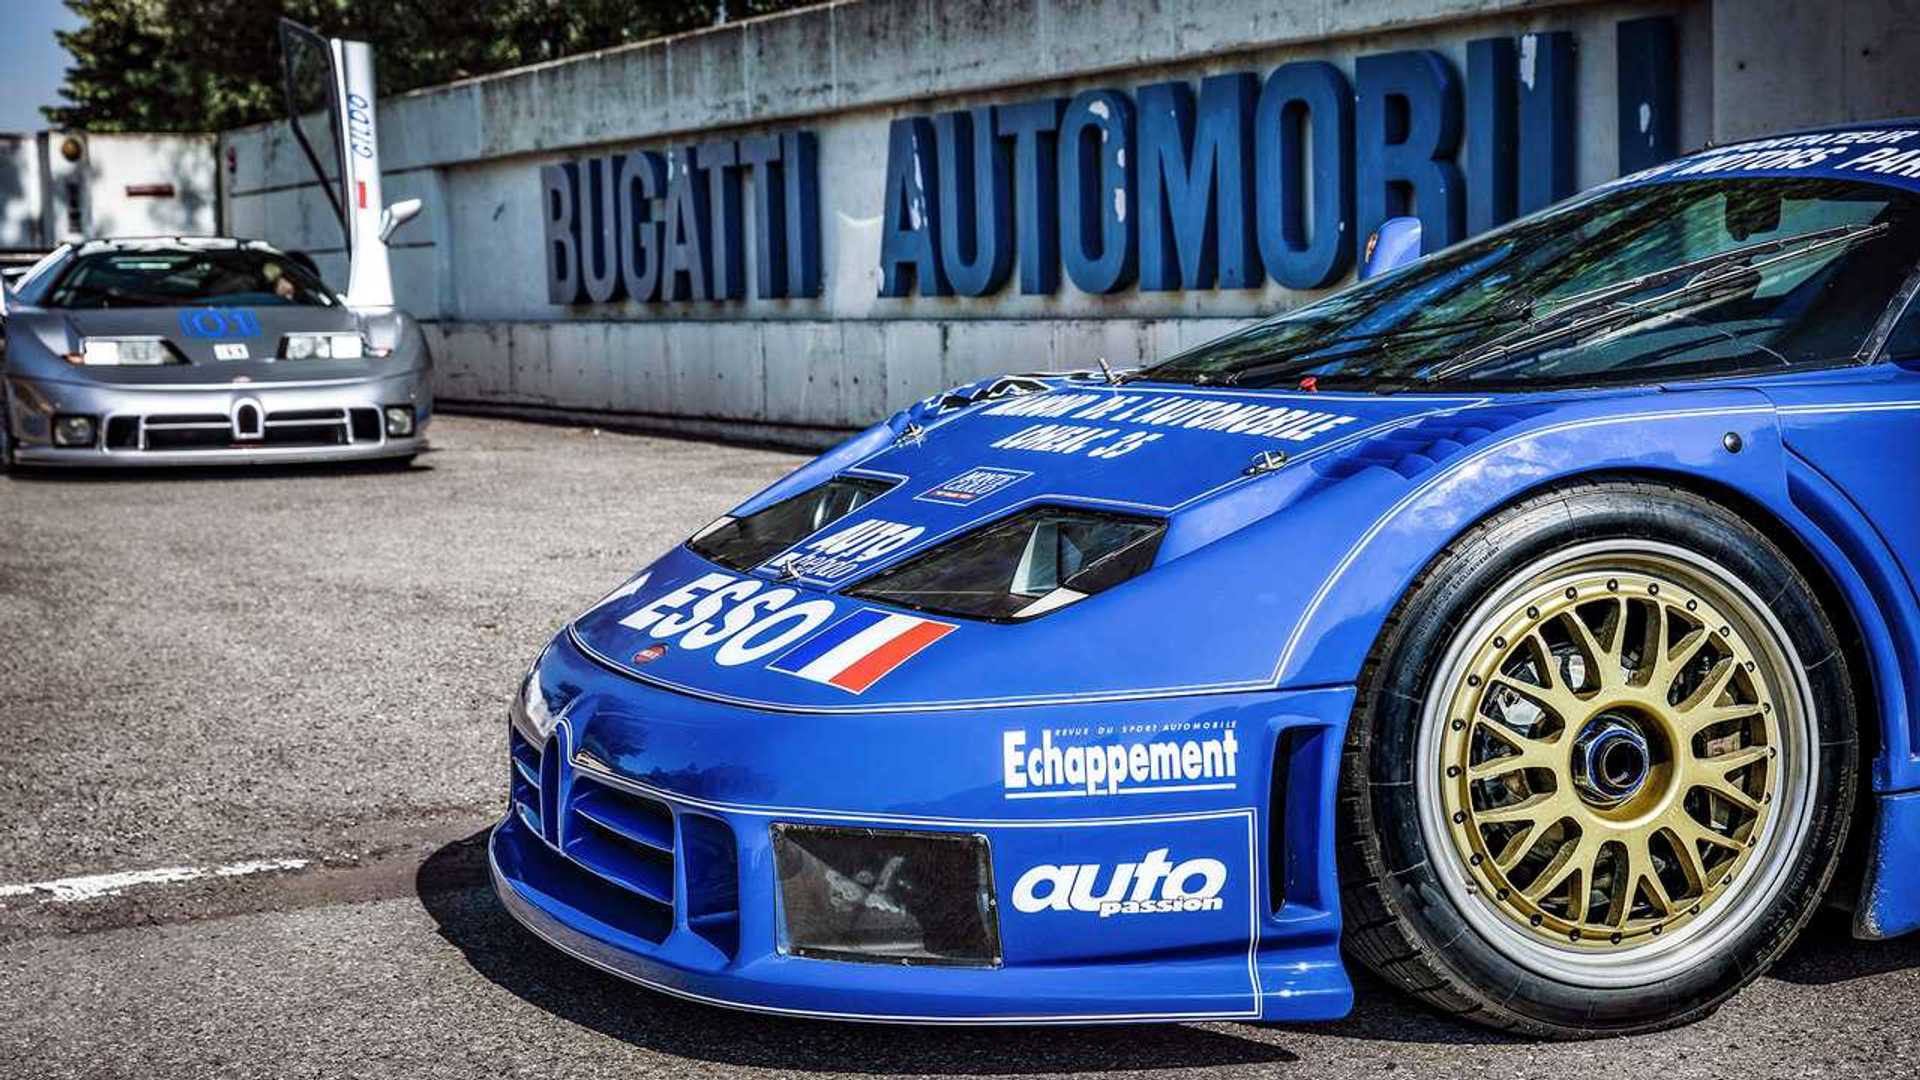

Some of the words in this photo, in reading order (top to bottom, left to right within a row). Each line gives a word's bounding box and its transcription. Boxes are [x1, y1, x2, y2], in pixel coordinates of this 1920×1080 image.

[348, 94, 373, 158] GILDO
[541, 131, 821, 305] BUGATTI
[1070, 395, 1142, 421] DE
[1109, 396, 1357, 442] L'AUTOMOBILE
[1087, 430, 1165, 459] 35
[805, 518, 926, 563] AUTO
[617, 571, 837, 667] ESSO
[1055, 727, 1089, 737] REVUE
[1097, 726, 1114, 735] DU
[1161, 720, 1238, 733] AUTOMOBILE
[1003, 729, 1238, 795] Echappement
[1011, 847, 1228, 914] auto
[1099, 896, 1223, 919] passion
